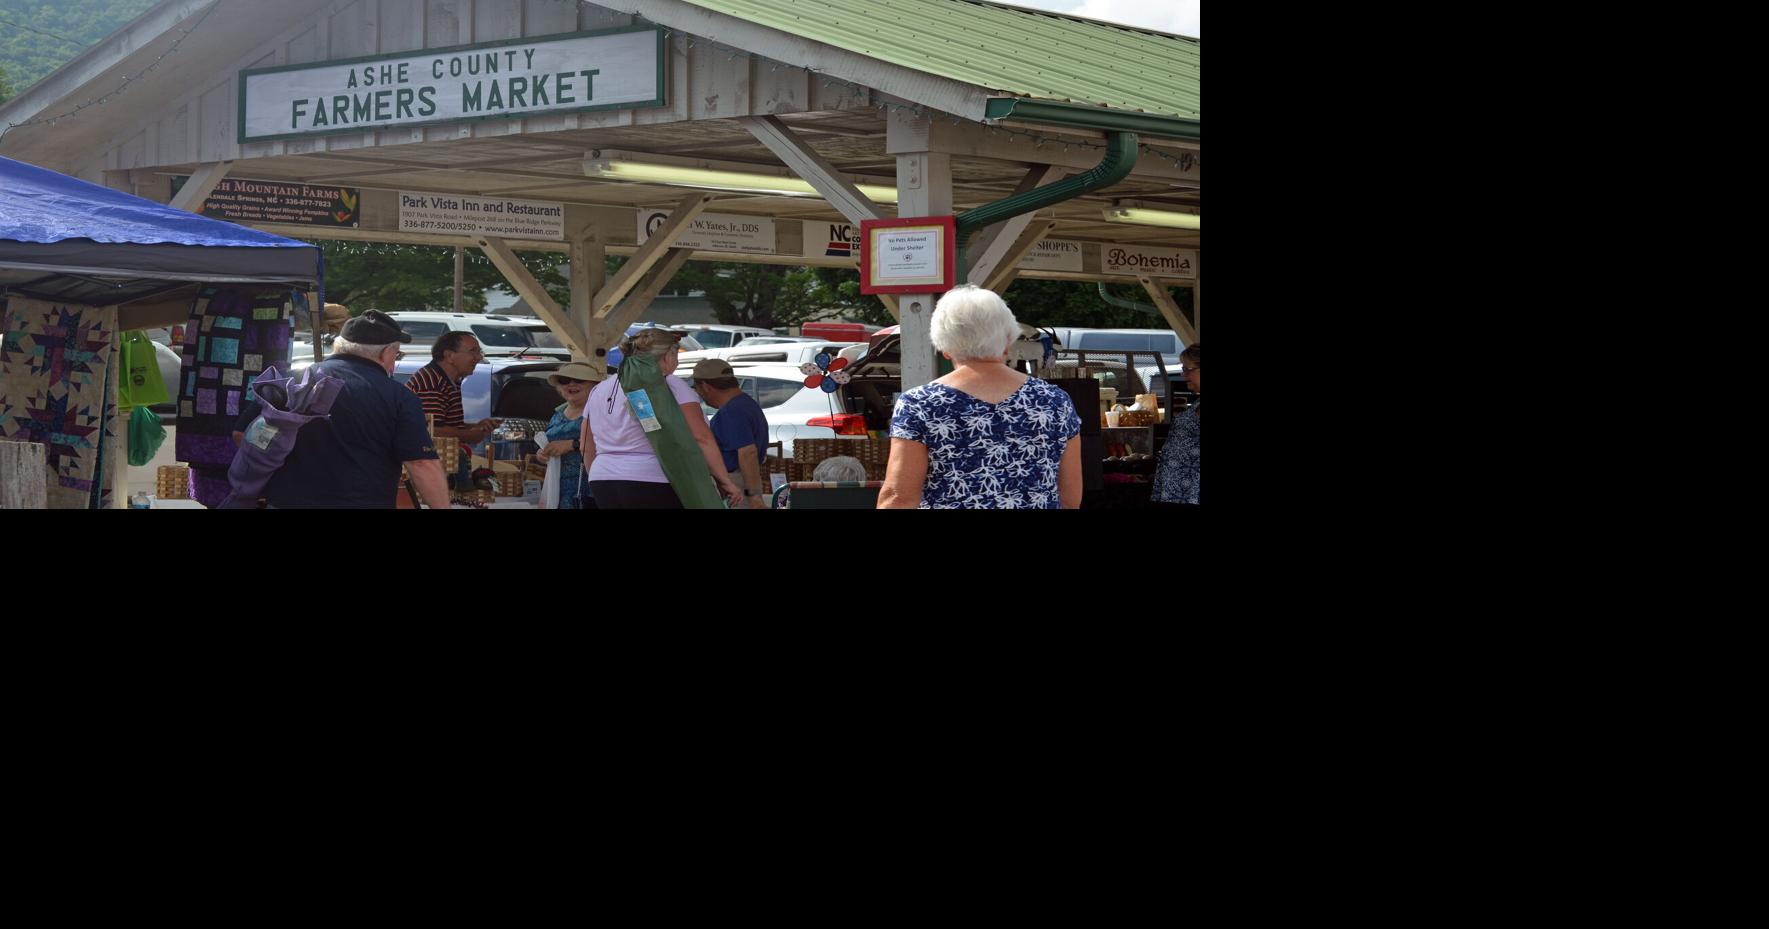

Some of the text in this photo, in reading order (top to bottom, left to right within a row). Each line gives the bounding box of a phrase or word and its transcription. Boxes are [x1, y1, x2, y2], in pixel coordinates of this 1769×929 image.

[347, 48, 536, 89] ASHE COUNTY
[292, 68, 600, 128] FARMERS MARKET
[302, 186, 339, 199] FARMS
[403, 195, 560, 216] Park Vista Inn and Restaurant
[404, 220, 560, 236] 336-877-5200/5250 www.parkvistainn.com
[742, 224, 759, 232] DDS
[830, 224, 851, 242] NC
[1038, 240, 1078, 252] SHOPPE'S
[1107, 248, 1191, 269] Bohemia
